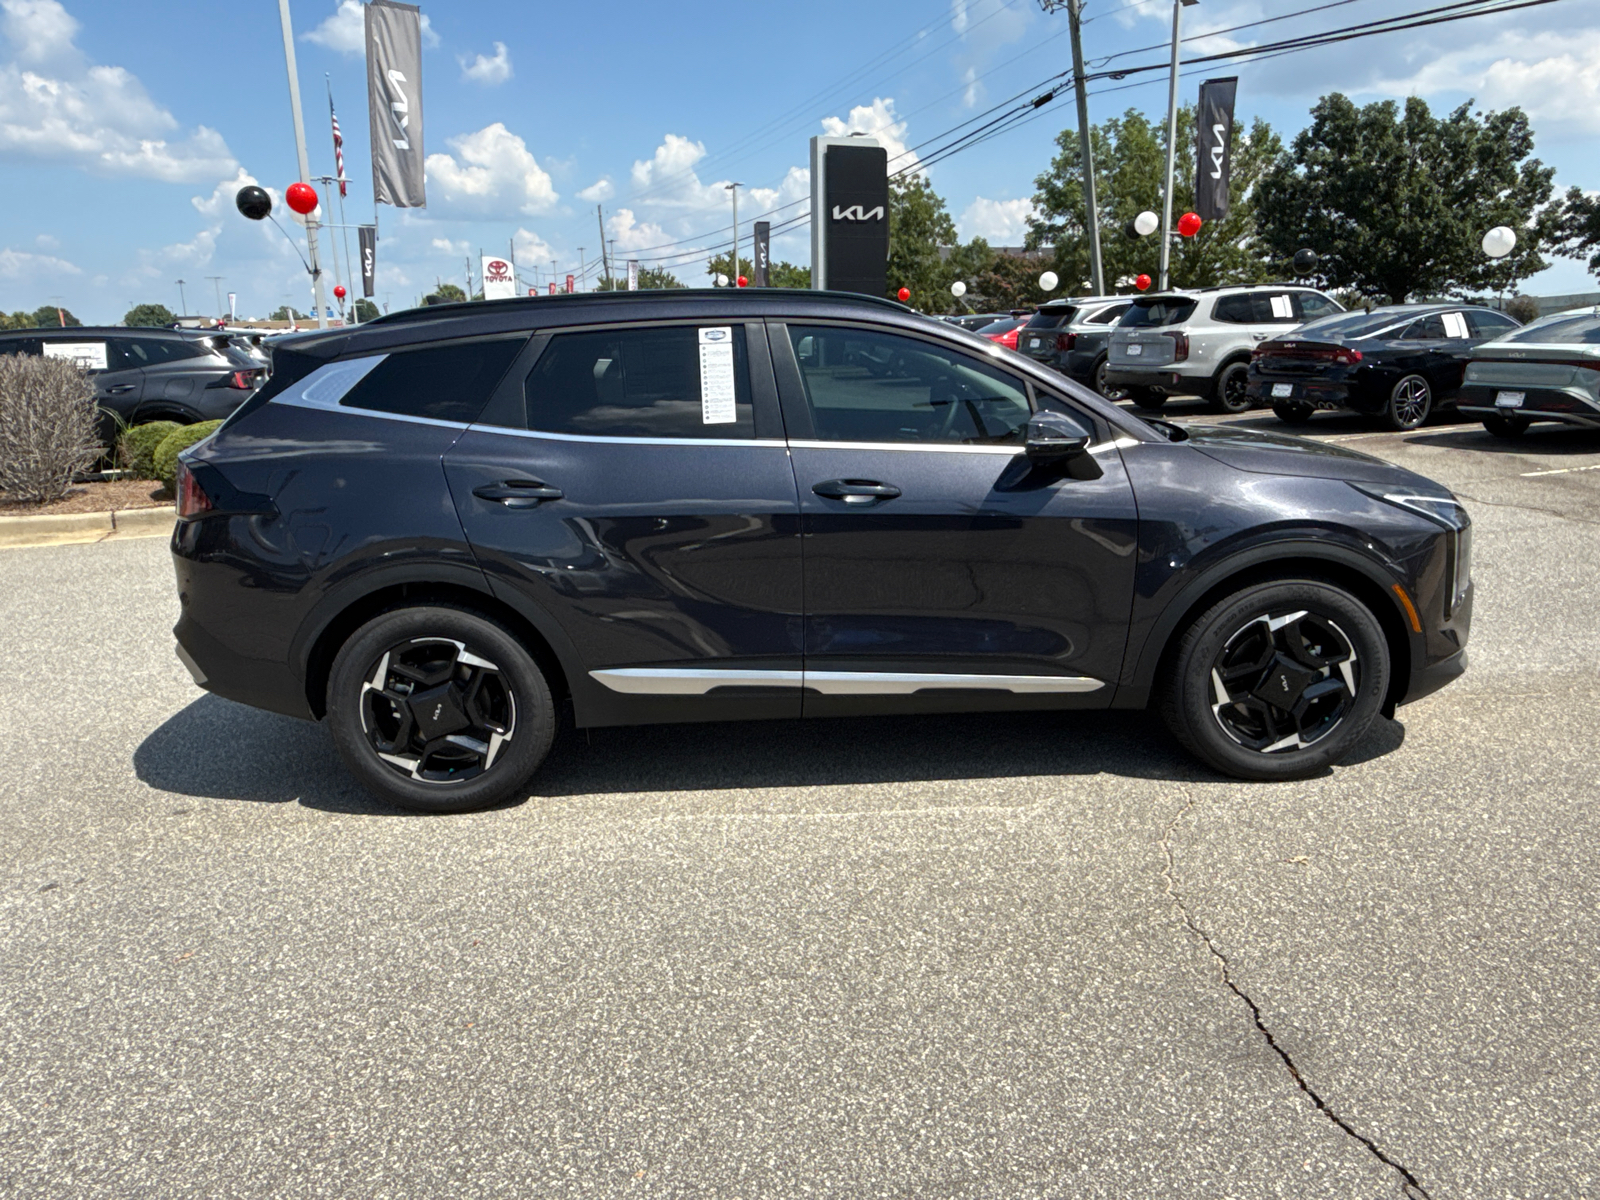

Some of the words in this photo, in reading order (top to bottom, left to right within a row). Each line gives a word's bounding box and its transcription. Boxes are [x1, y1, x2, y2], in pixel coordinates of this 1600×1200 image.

[388, 69, 410, 150] KIA
[1210, 124, 1226, 180] KIA
[832, 204, 885, 221] KIA
[485, 275, 513, 283] TOYOTA
